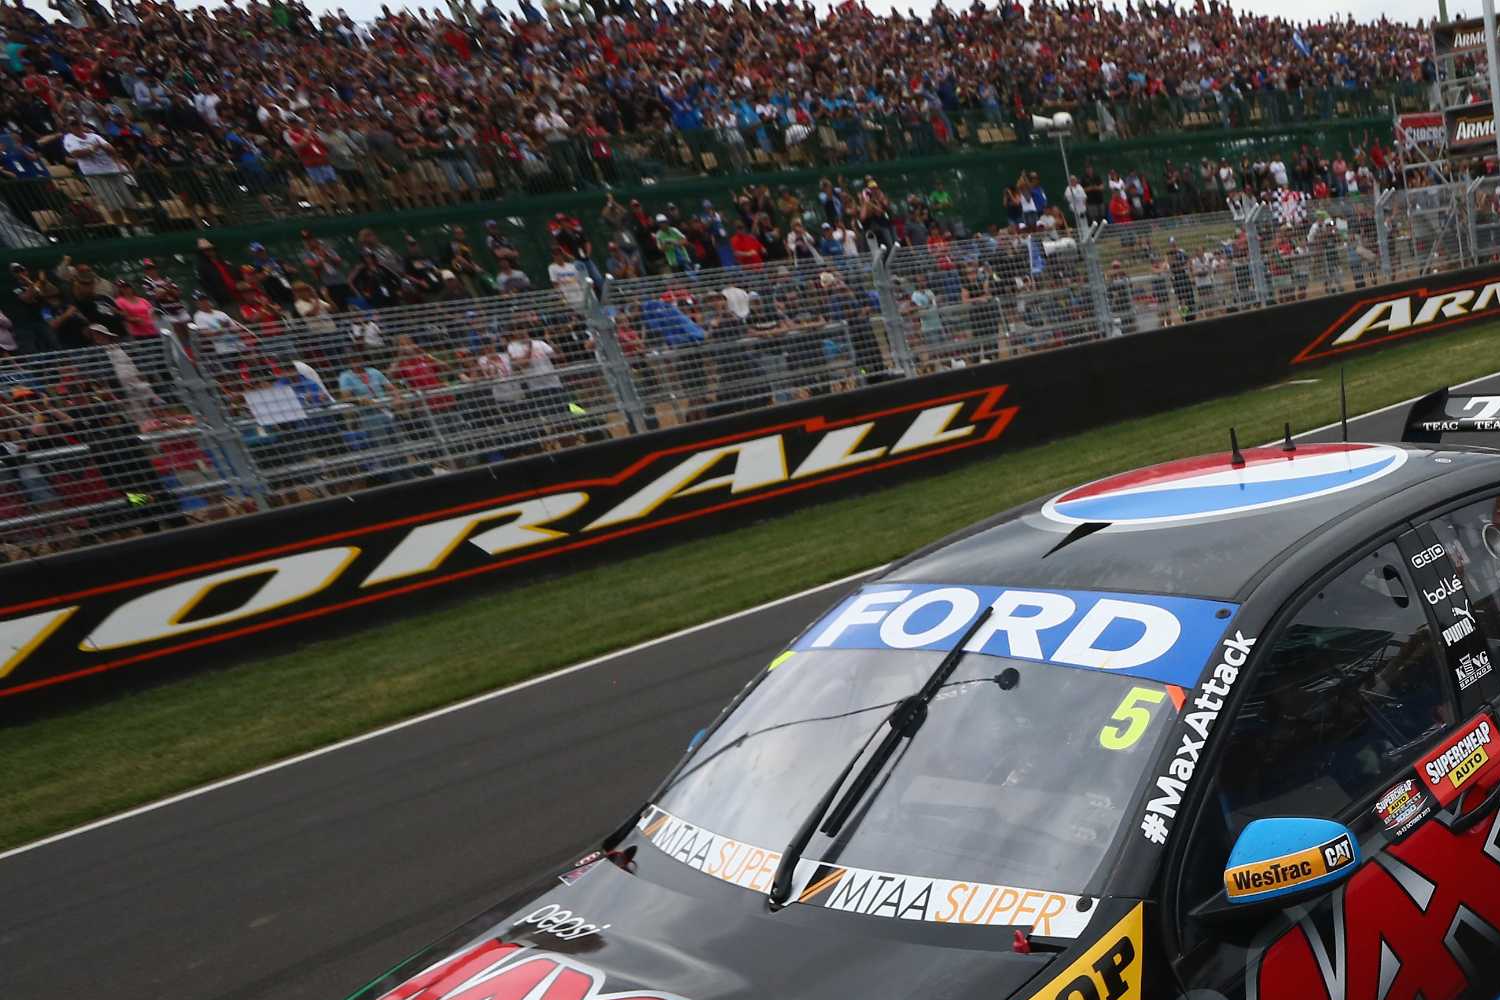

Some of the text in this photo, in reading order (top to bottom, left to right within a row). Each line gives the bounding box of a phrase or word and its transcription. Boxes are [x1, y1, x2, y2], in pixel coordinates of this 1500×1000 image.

[1454, 31, 1489, 48] ARMO
[1456, 119, 1497, 140] ARMO
[1422, 421, 1459, 431] TEAC
[584, 402, 977, 531] ALL
[1423, 573, 1464, 605] bollé
[810, 586, 1182, 671] FORD
[1442, 618, 1475, 647] PUMA
[1098, 686, 1167, 751] 5
[1141, 629, 1257, 848] #MaxAttack
[1425, 721, 1490, 785] SUPERCHEAP
[1455, 753, 1482, 782] AUTO
[1375, 779, 1413, 814] SUPERCHEAP
[1390, 795, 1407, 812] AUTO
[653, 820, 783, 892] MTAA SUPE
[1324, 839, 1351, 868] CAT
[1232, 860, 1312, 891] WesTrac
[826, 872, 1066, 936] MTAA SUPER
[513, 902, 611, 943] pepsi
